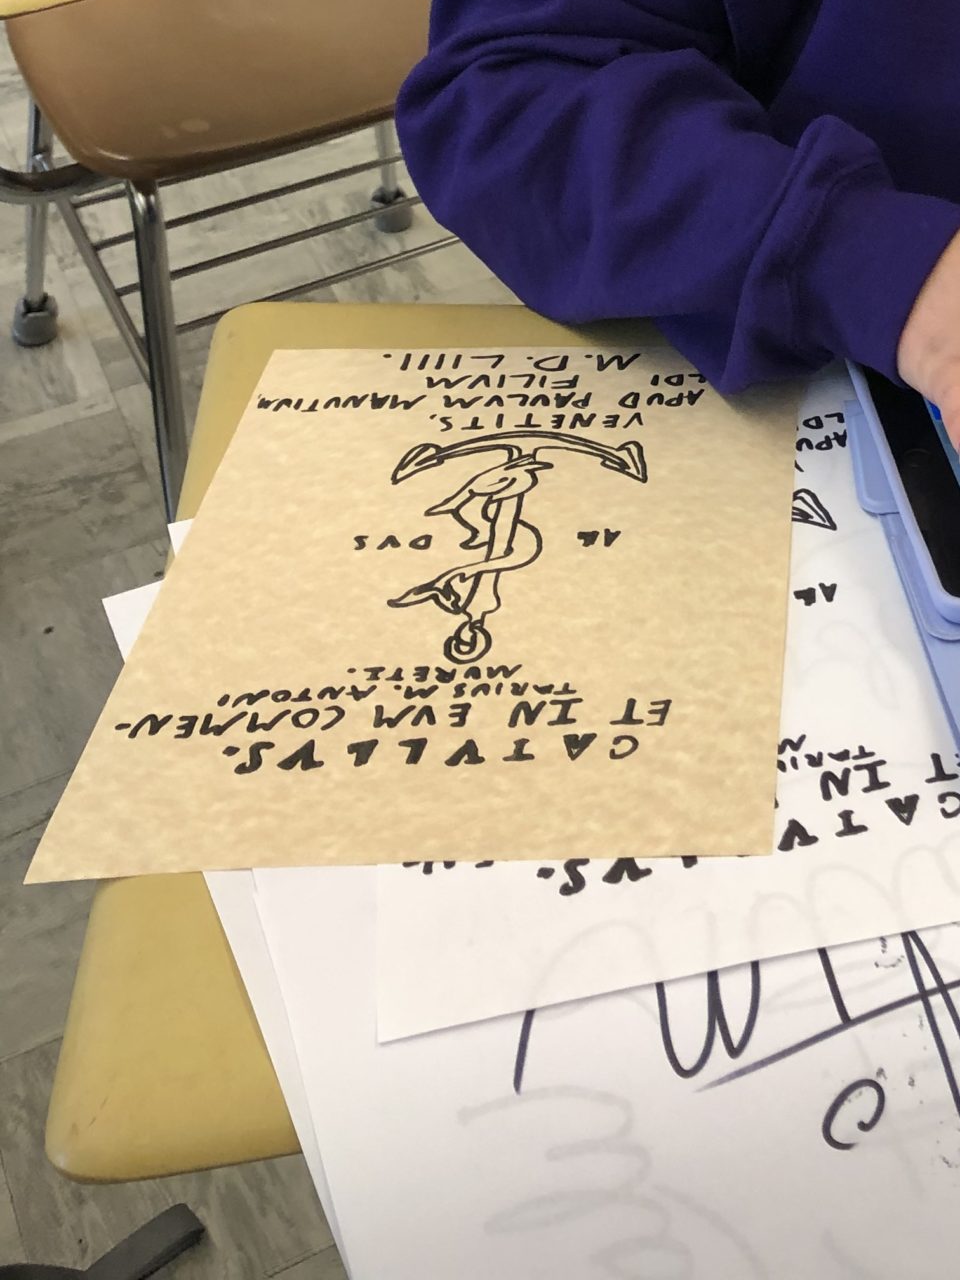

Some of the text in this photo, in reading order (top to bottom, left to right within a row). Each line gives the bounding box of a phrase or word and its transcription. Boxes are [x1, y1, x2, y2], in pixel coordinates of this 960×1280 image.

[527, 355, 569, 372] D.
[586, 353, 641, 371] M.
[650, 373, 706, 386] LDI
[803, 412, 845, 430] LD
[796, 429, 848, 452] APU
[353, 534, 433, 550] DVS
[394, 683, 439, 699] M.
[115, 697, 672, 739] ET IN EVM COMMEN-
[222, 732, 639, 774] CATVLLVS.
[820, 760, 891, 801] IN
